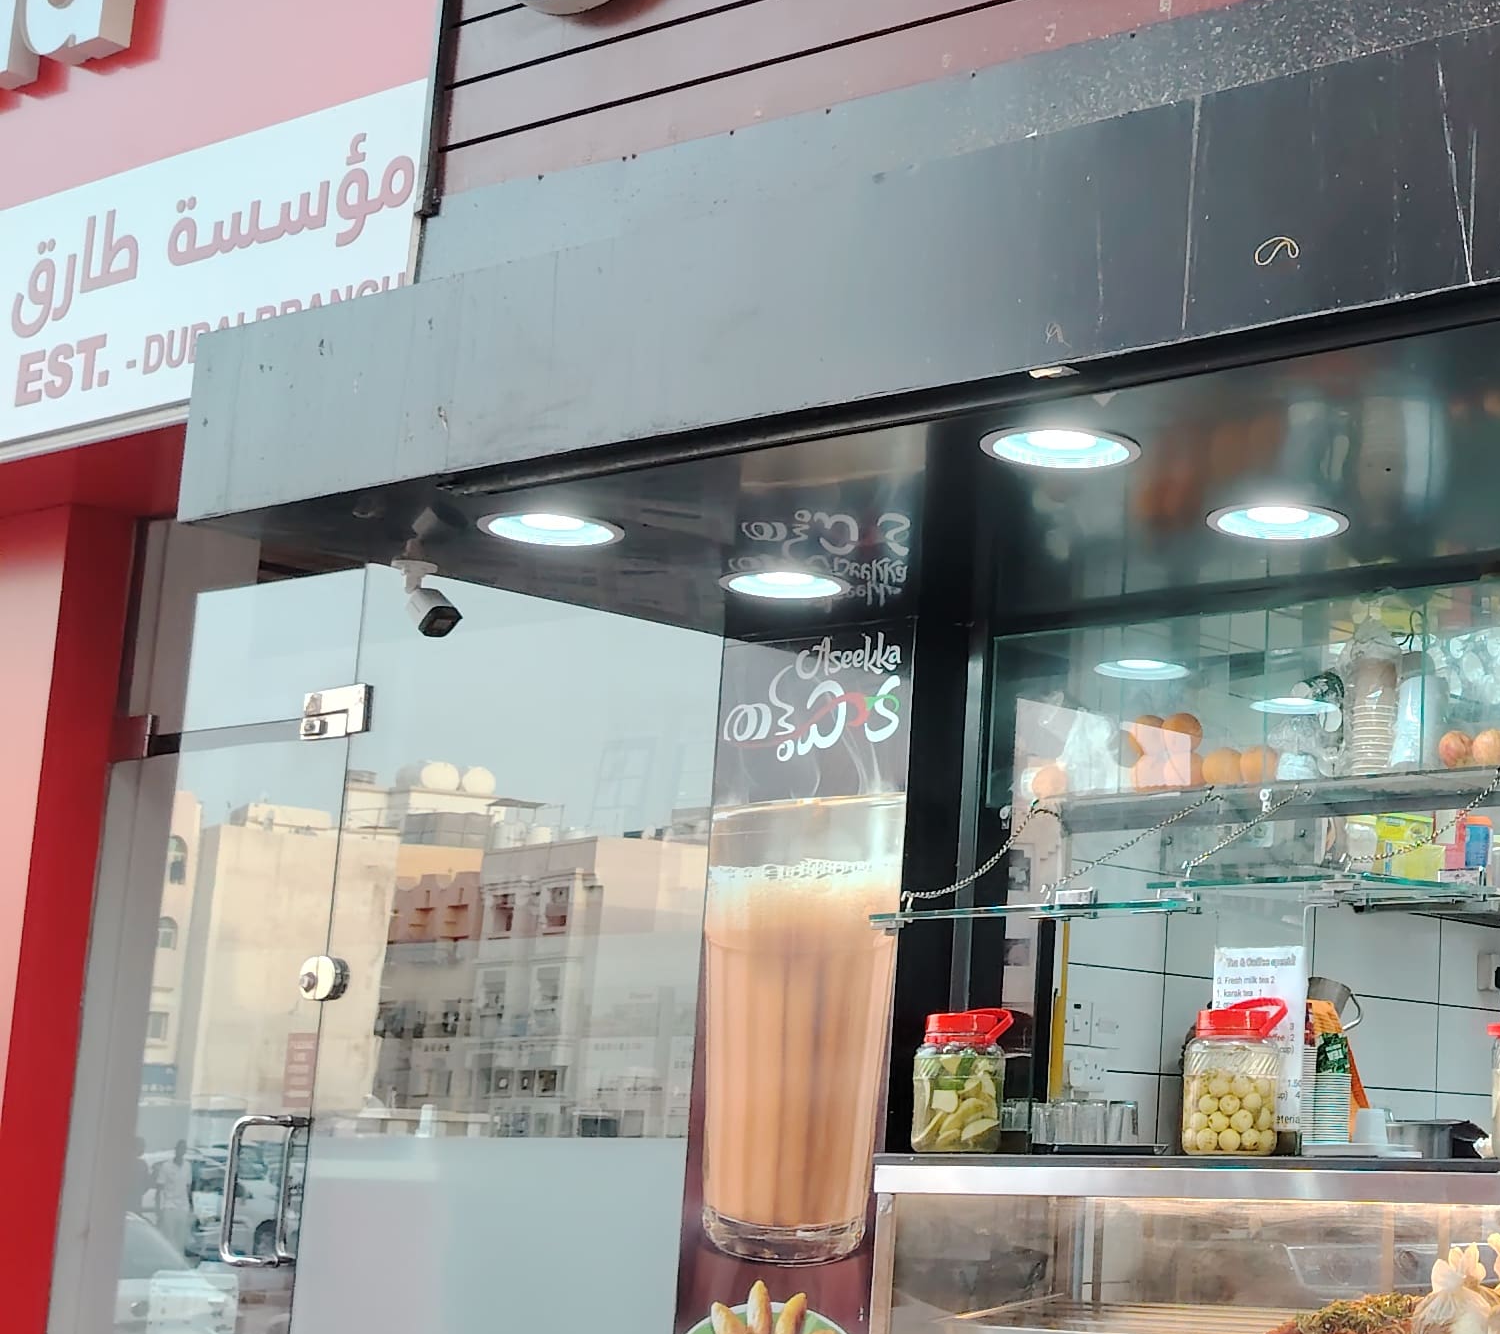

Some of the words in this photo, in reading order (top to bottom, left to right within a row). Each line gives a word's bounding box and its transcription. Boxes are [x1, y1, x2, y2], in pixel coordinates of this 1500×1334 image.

[166, 133, 416, 267] مؤسسة
[11, 207, 140, 339] طارق
[14, 333, 109, 407] EST.
[795, 631, 902, 681] Aseekka
